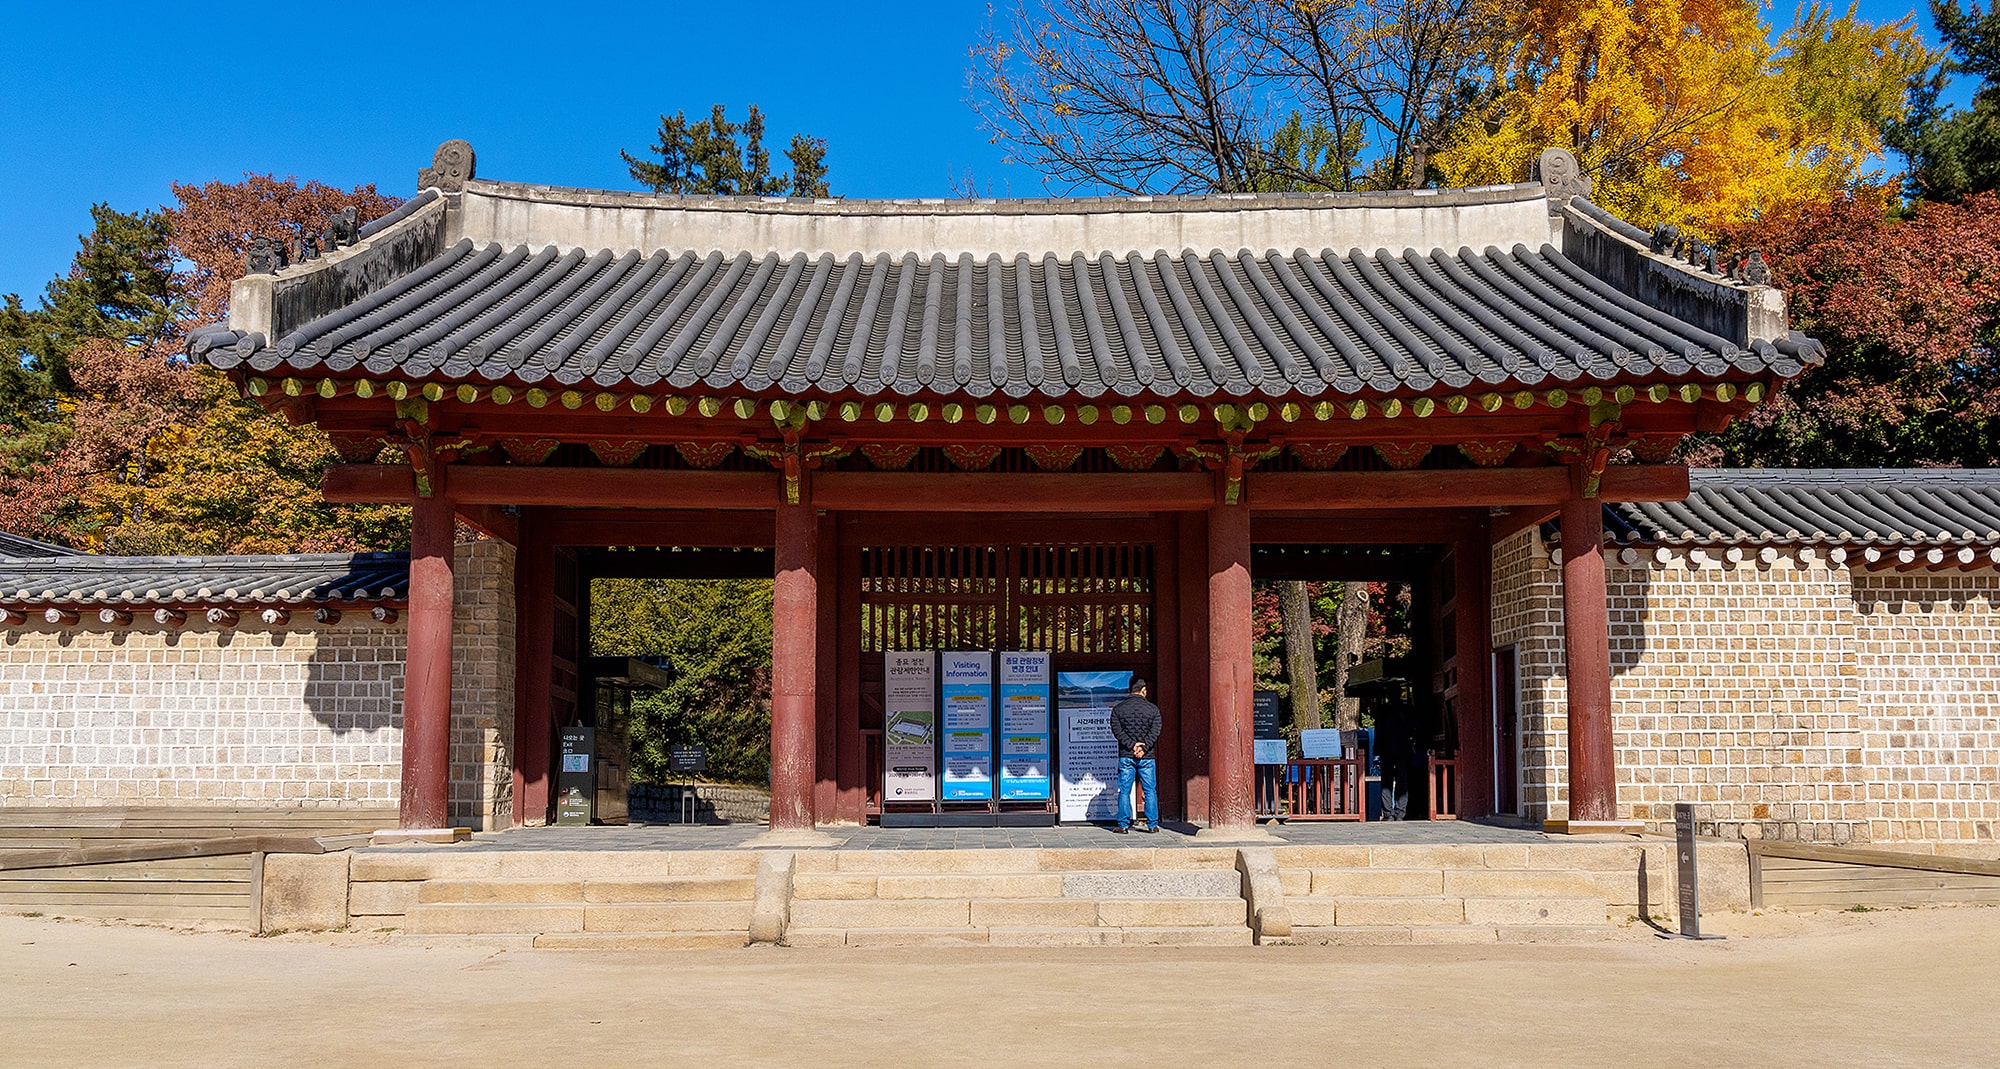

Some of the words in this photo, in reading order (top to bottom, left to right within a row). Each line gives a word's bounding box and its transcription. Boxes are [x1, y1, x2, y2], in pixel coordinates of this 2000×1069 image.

[1006, 657, 1018, 665] 종묘
[1020, 657, 1045, 665] 관람정보
[953, 661, 981, 670] Visiting
[1012, 665, 1024, 673] 변경
[1025, 665, 1038, 673] 안내
